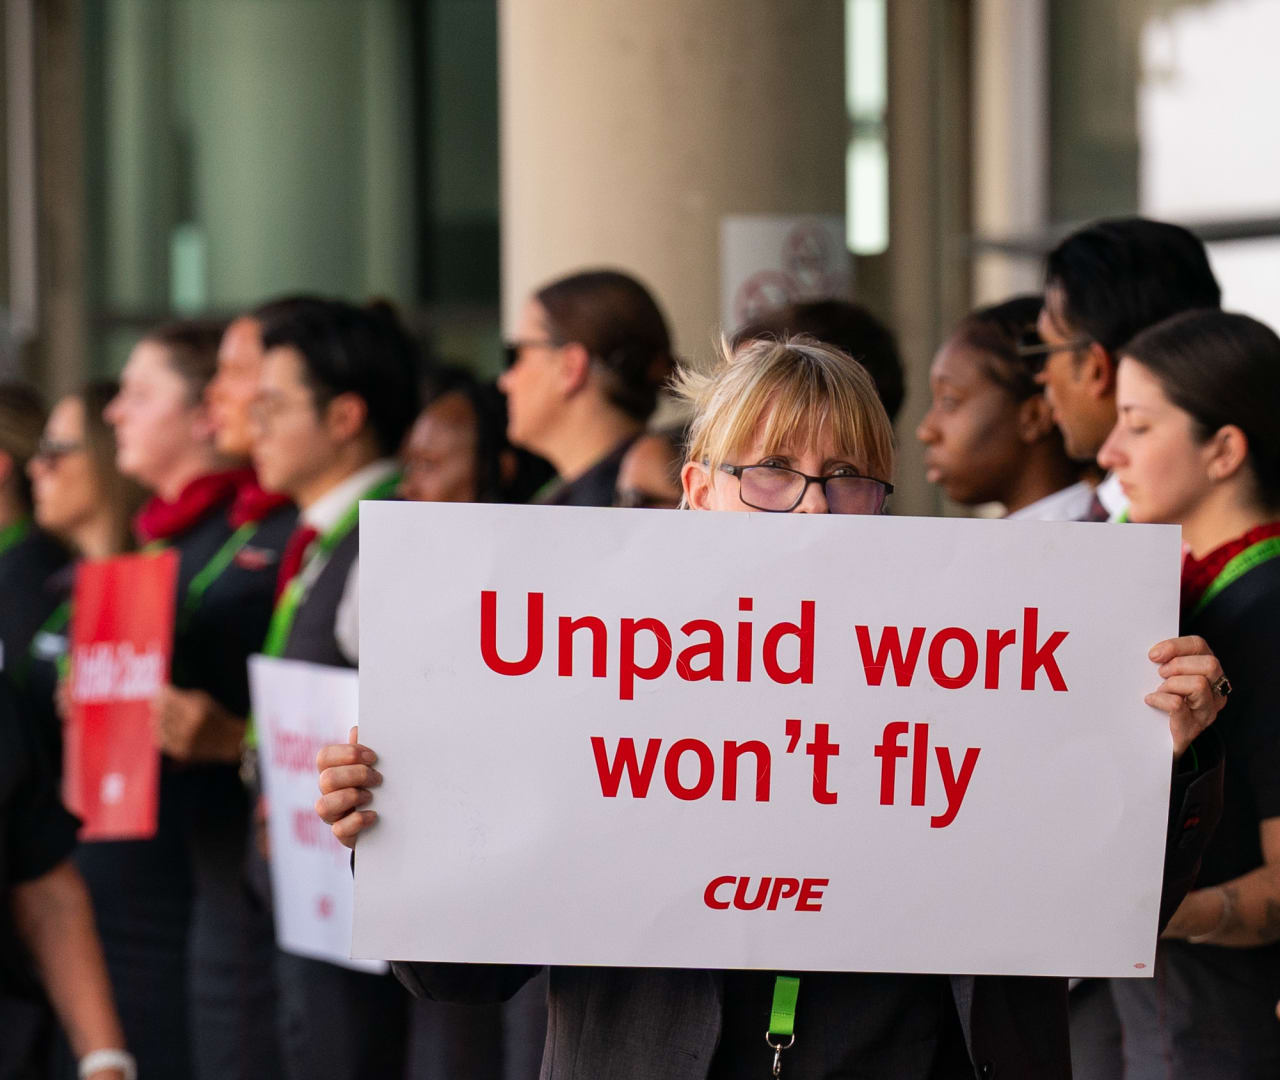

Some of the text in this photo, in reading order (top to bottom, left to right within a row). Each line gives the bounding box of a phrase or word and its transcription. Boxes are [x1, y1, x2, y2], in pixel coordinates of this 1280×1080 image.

[480, 590, 1069, 700] Unpaid work
[590, 719, 981, 828] won't fly
[704, 875, 829, 912] CUPE
